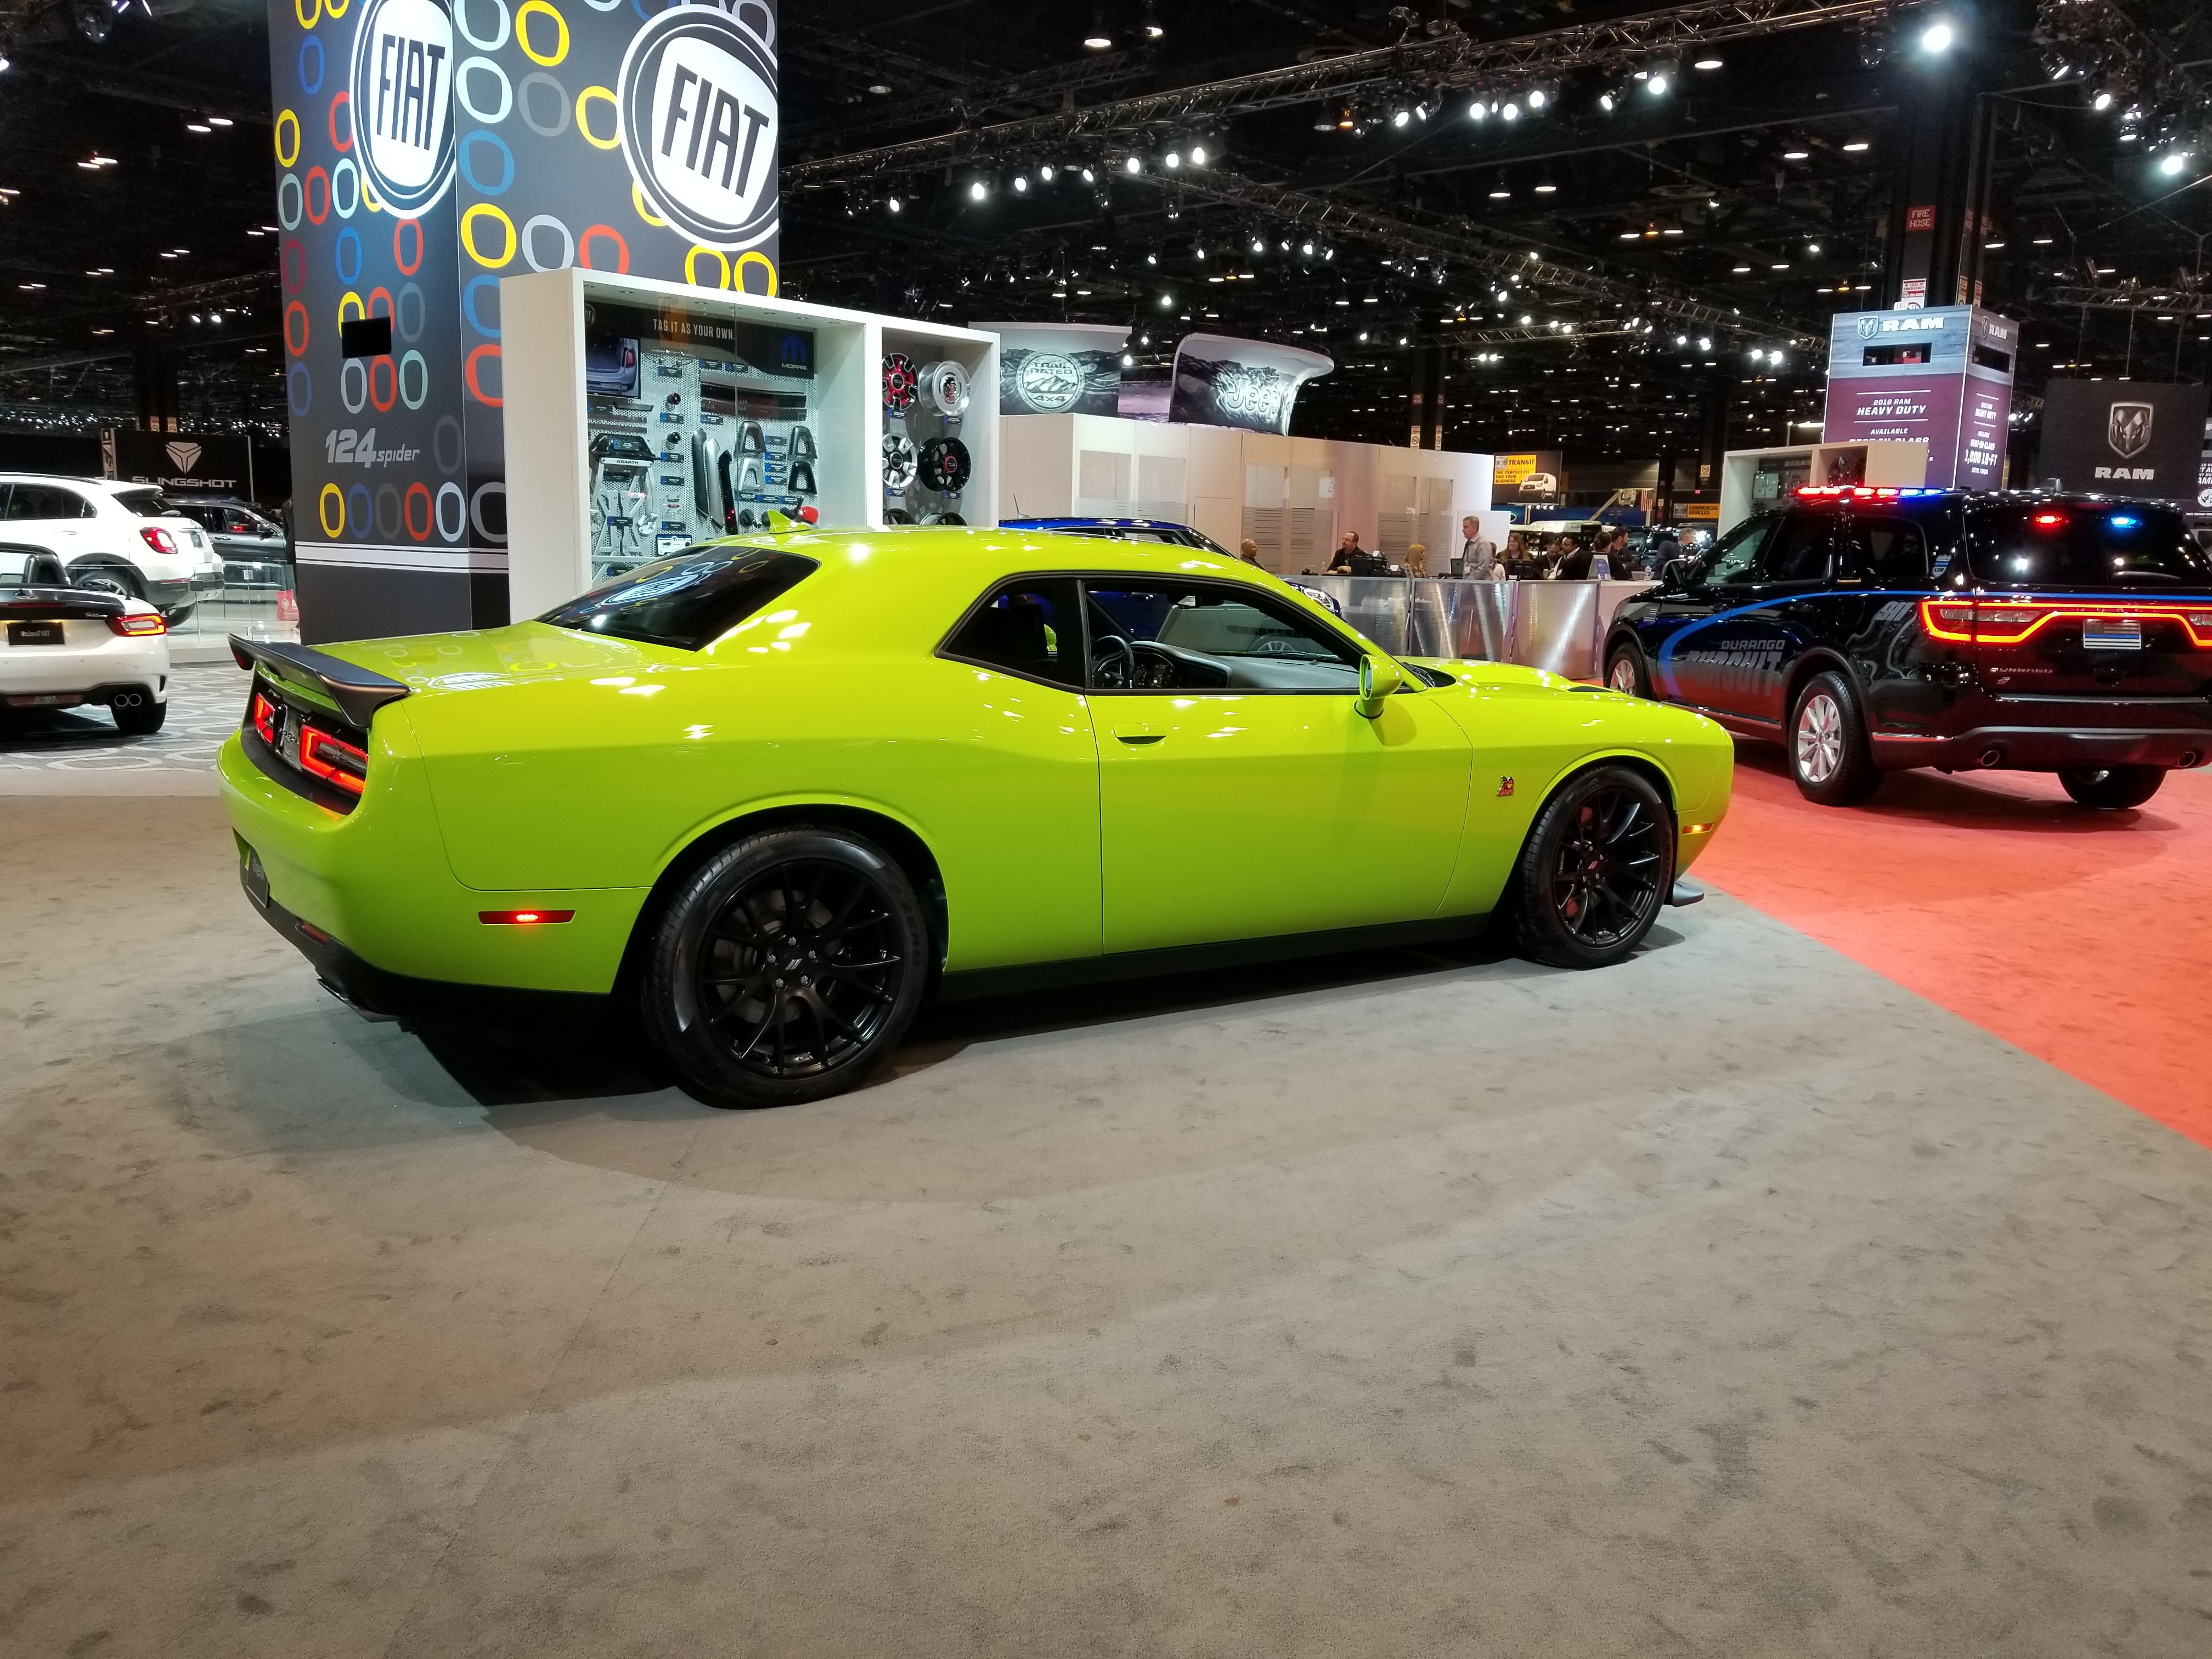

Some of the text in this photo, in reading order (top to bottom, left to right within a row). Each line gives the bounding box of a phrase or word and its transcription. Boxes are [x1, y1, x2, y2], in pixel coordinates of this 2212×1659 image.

[375, 33, 445, 151] FIAT
[661, 63, 770, 199] FIAT
[1911, 209, 1930, 218] FIRE
[1910, 219, 1931, 228] HOSE
[653, 319, 735, 340] TAG IT AS YOUR OWN.
[1882, 317, 1944, 332] RAM
[1989, 324, 2008, 340] RAM
[1227, 377, 1280, 421] Jeep
[1857, 405, 1927, 415] HEAVY DUTY
[325, 428, 420, 468] 124 spider
[1965, 449, 1982, 464] 1,000
[2095, 467, 2154, 480] RAM
[132, 476, 237, 488] SLINGSHOT
[1720, 640, 1786, 650] DURANGO
